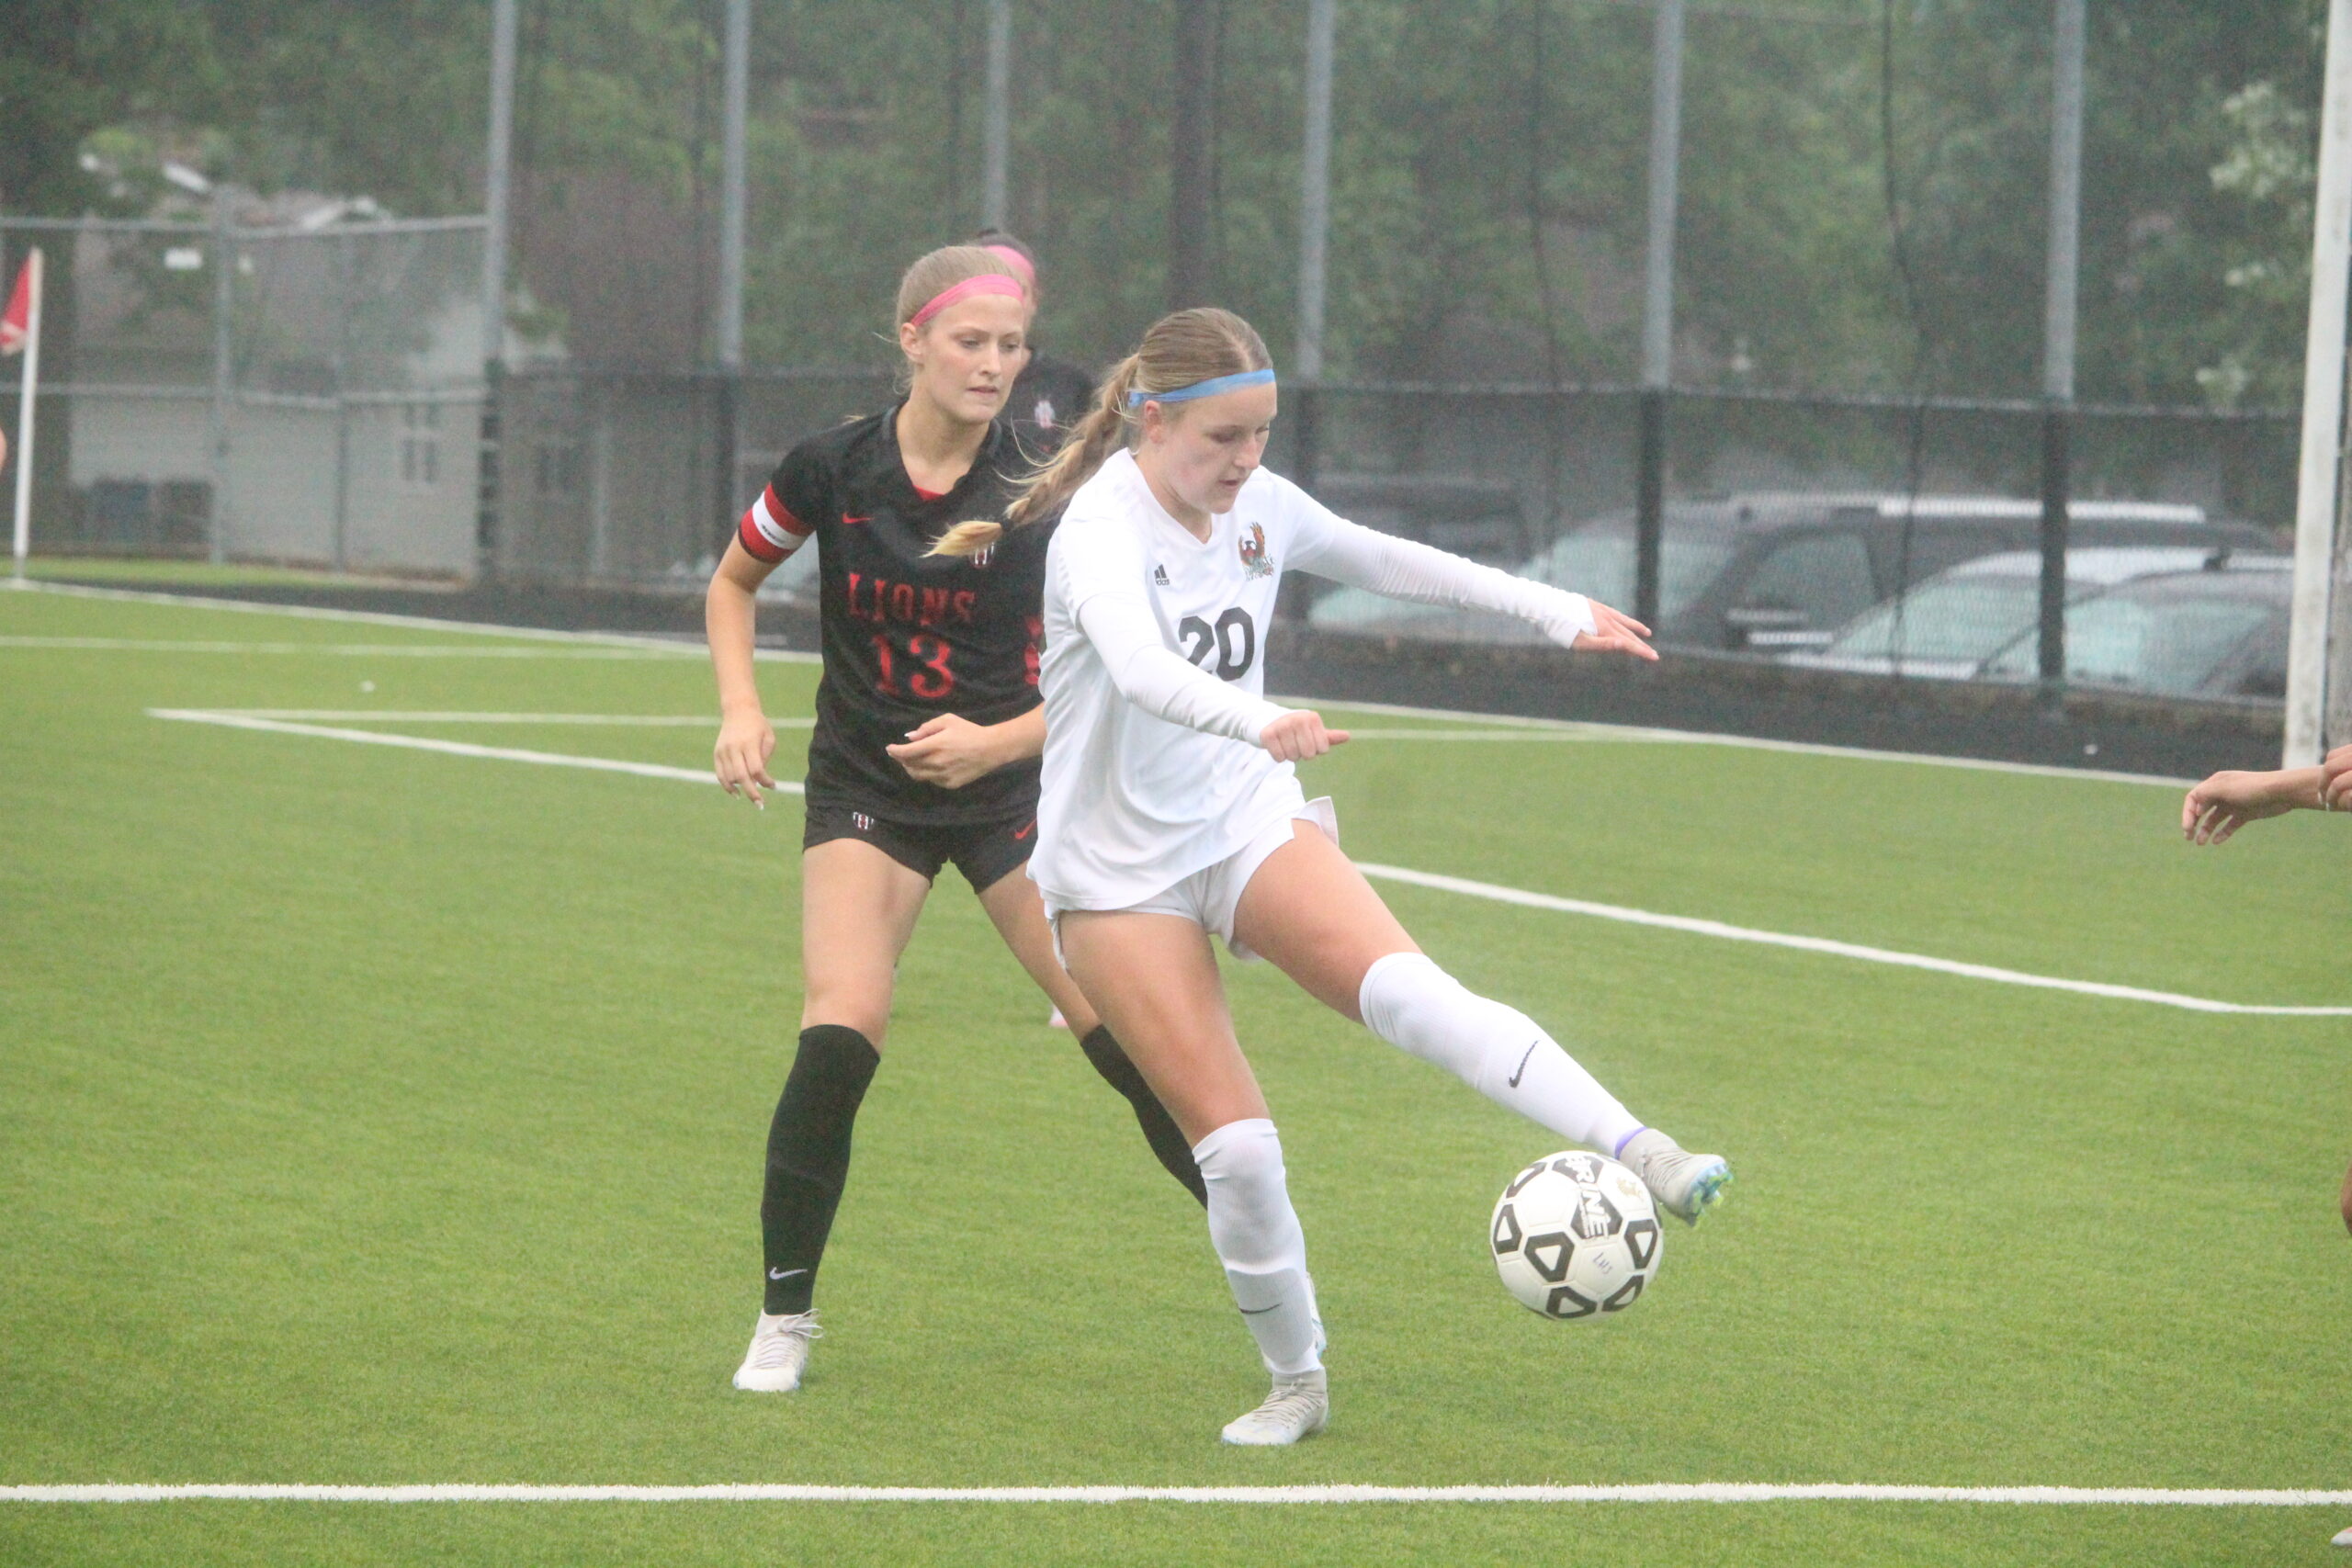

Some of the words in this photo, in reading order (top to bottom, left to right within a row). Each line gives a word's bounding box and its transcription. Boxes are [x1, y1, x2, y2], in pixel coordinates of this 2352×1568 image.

[848, 572, 976, 626] LIONS
[869, 632, 955, 699] 13
[1178, 606, 1255, 682] 20
